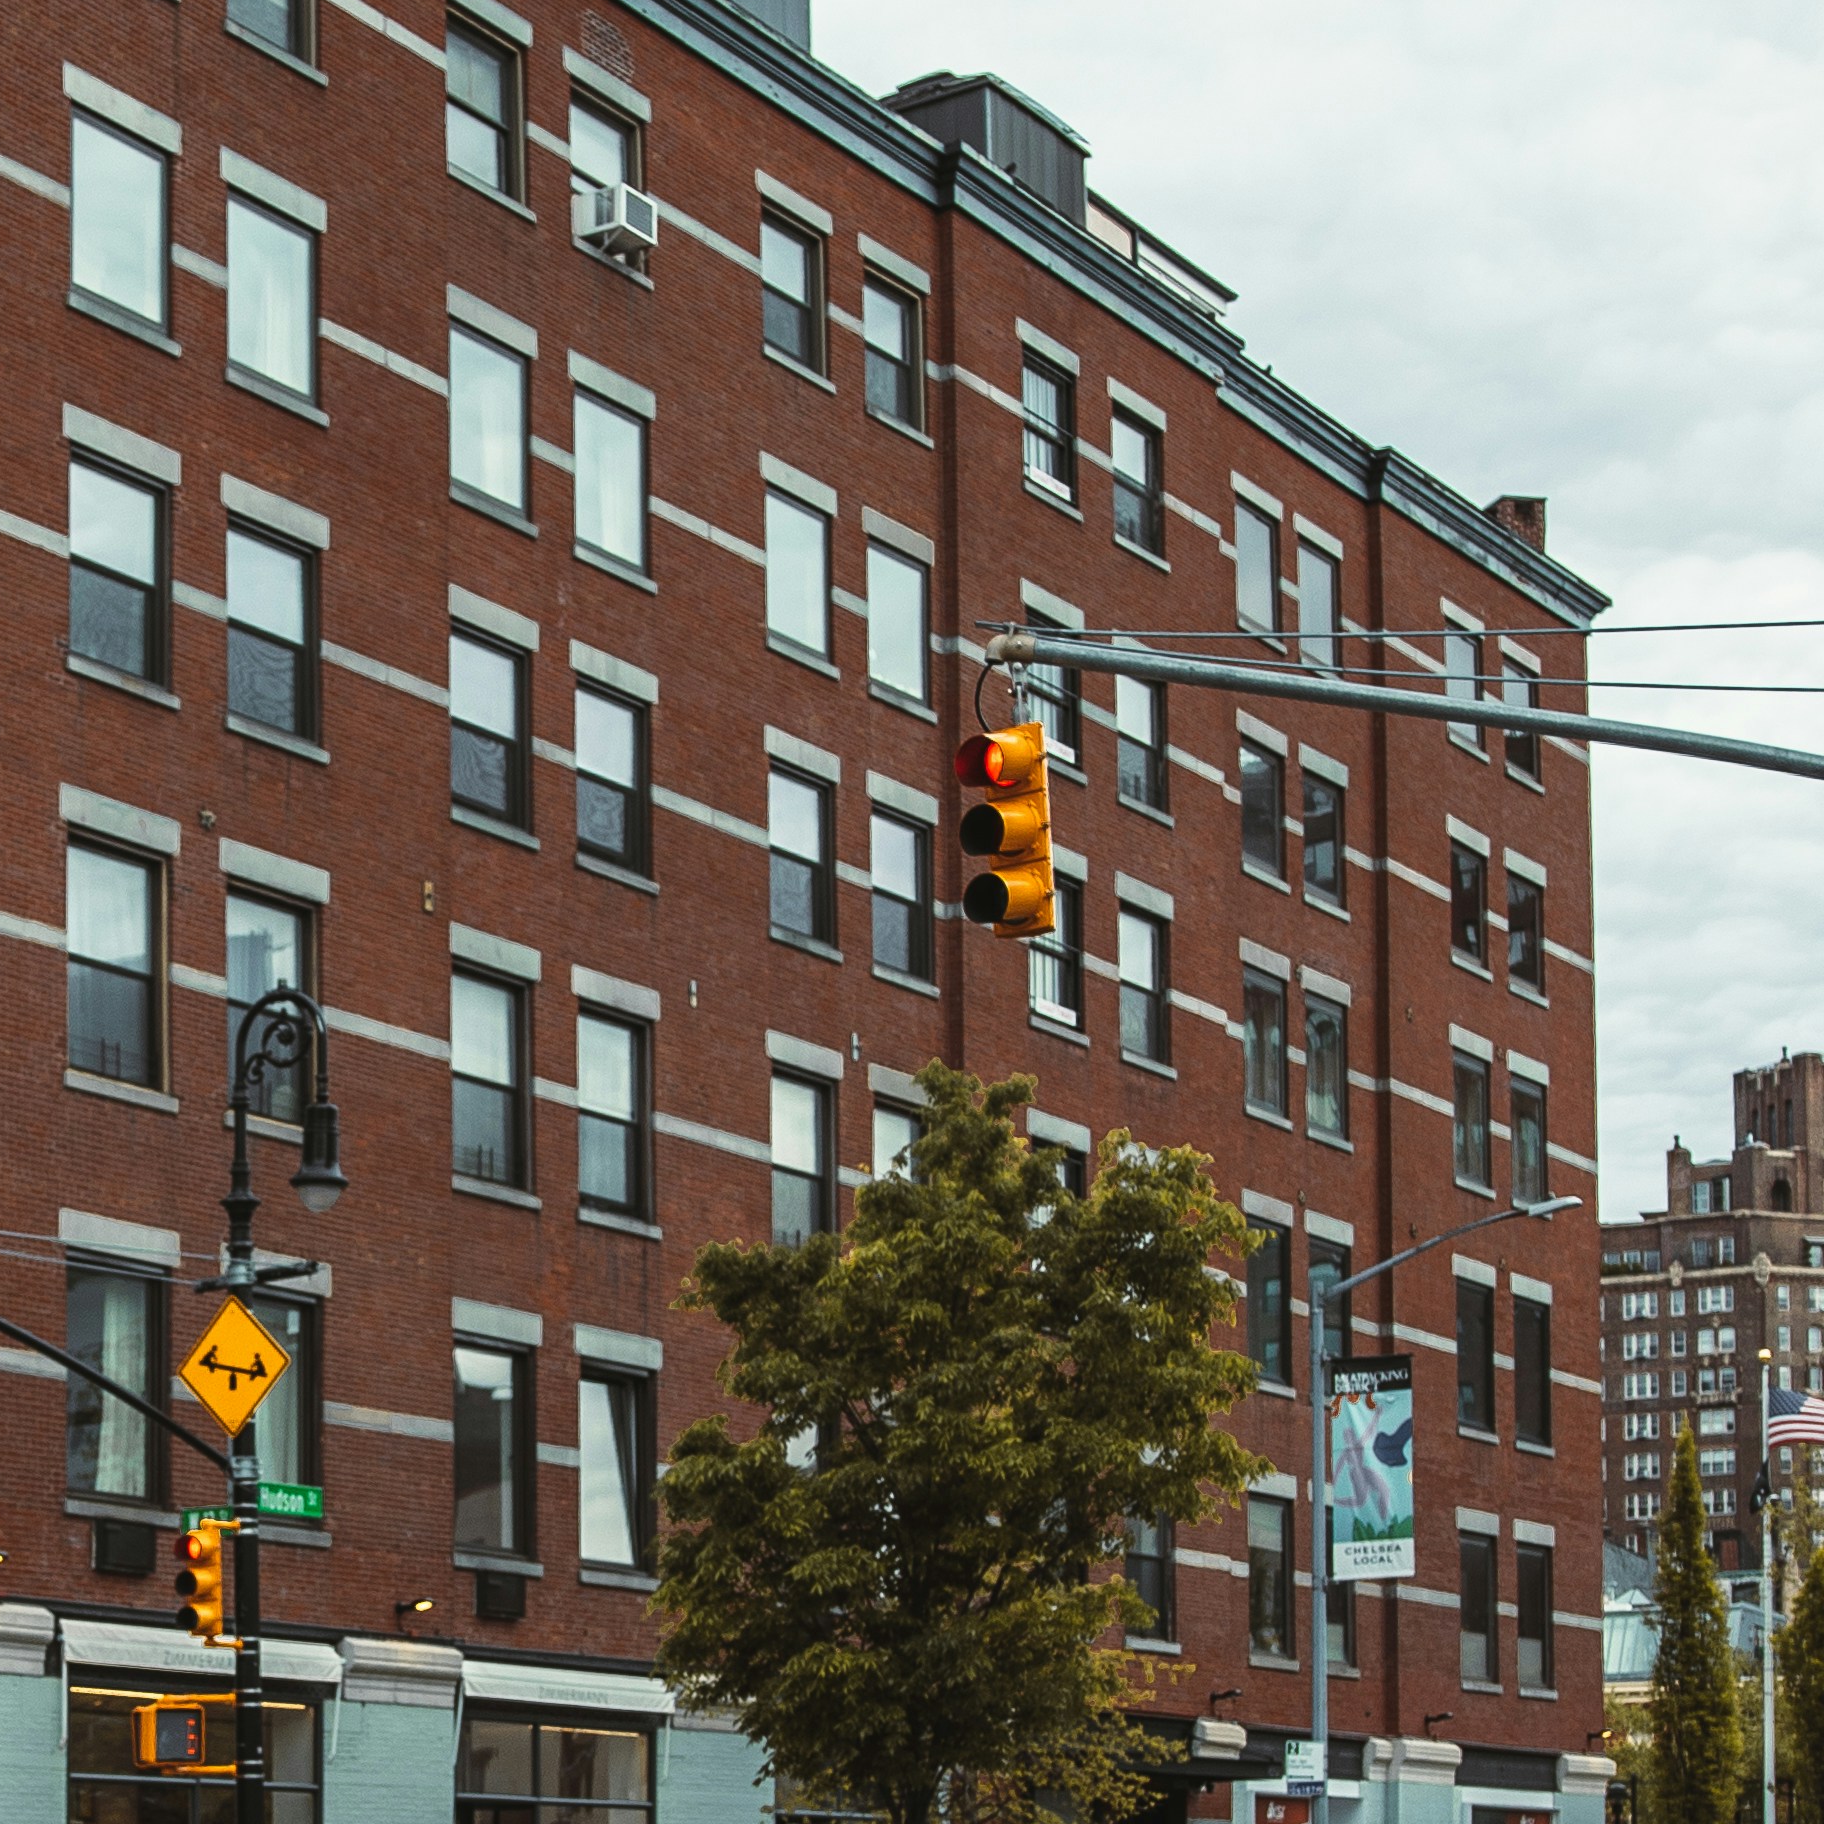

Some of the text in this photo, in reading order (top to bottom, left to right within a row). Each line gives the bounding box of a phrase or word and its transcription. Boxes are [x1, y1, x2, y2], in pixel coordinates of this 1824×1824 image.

[1334, 1367, 1409, 1384] MEATPACKING
[260, 1486, 305, 1513] Hudson
[1344, 1544, 1402, 1556] CHELSEA
[1353, 1555, 1393, 1566] LOCAL
